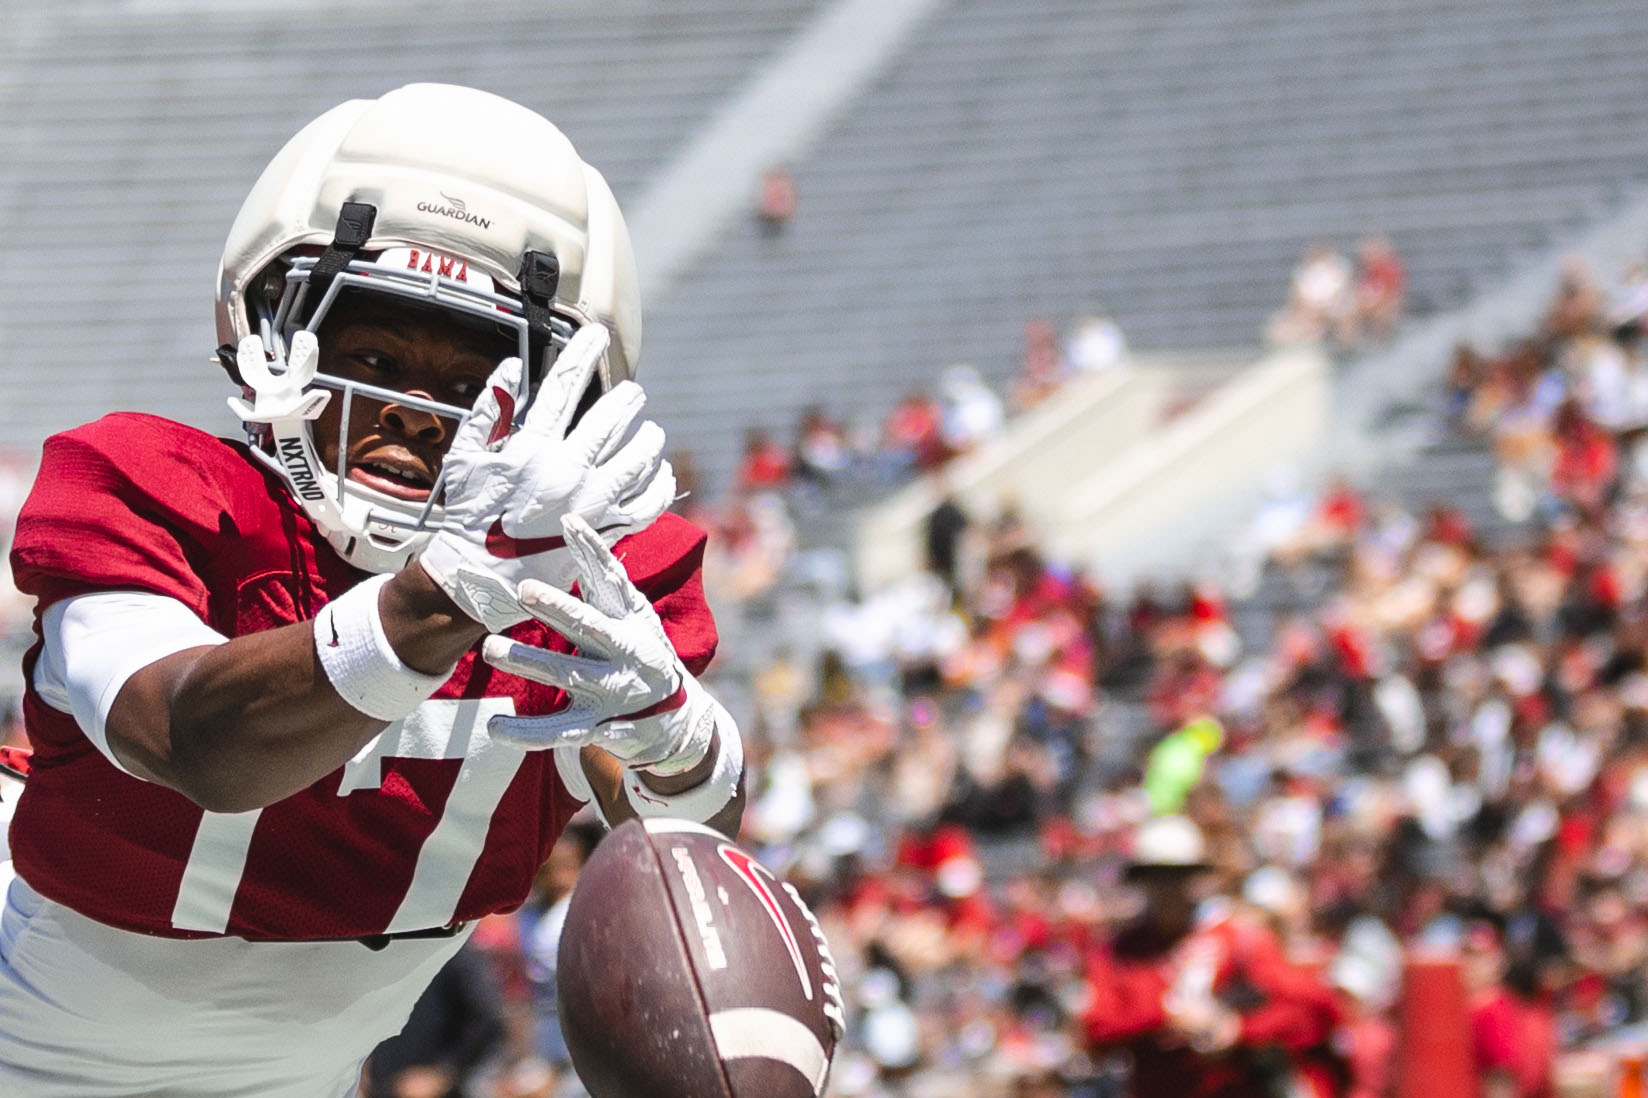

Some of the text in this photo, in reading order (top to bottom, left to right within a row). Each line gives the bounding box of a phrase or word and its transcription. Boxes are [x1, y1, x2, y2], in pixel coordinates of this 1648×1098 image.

[416, 201, 491, 230] GUARDIAN
[406, 248, 469, 283] BAMA
[278, 436, 326, 501] NXTRND
